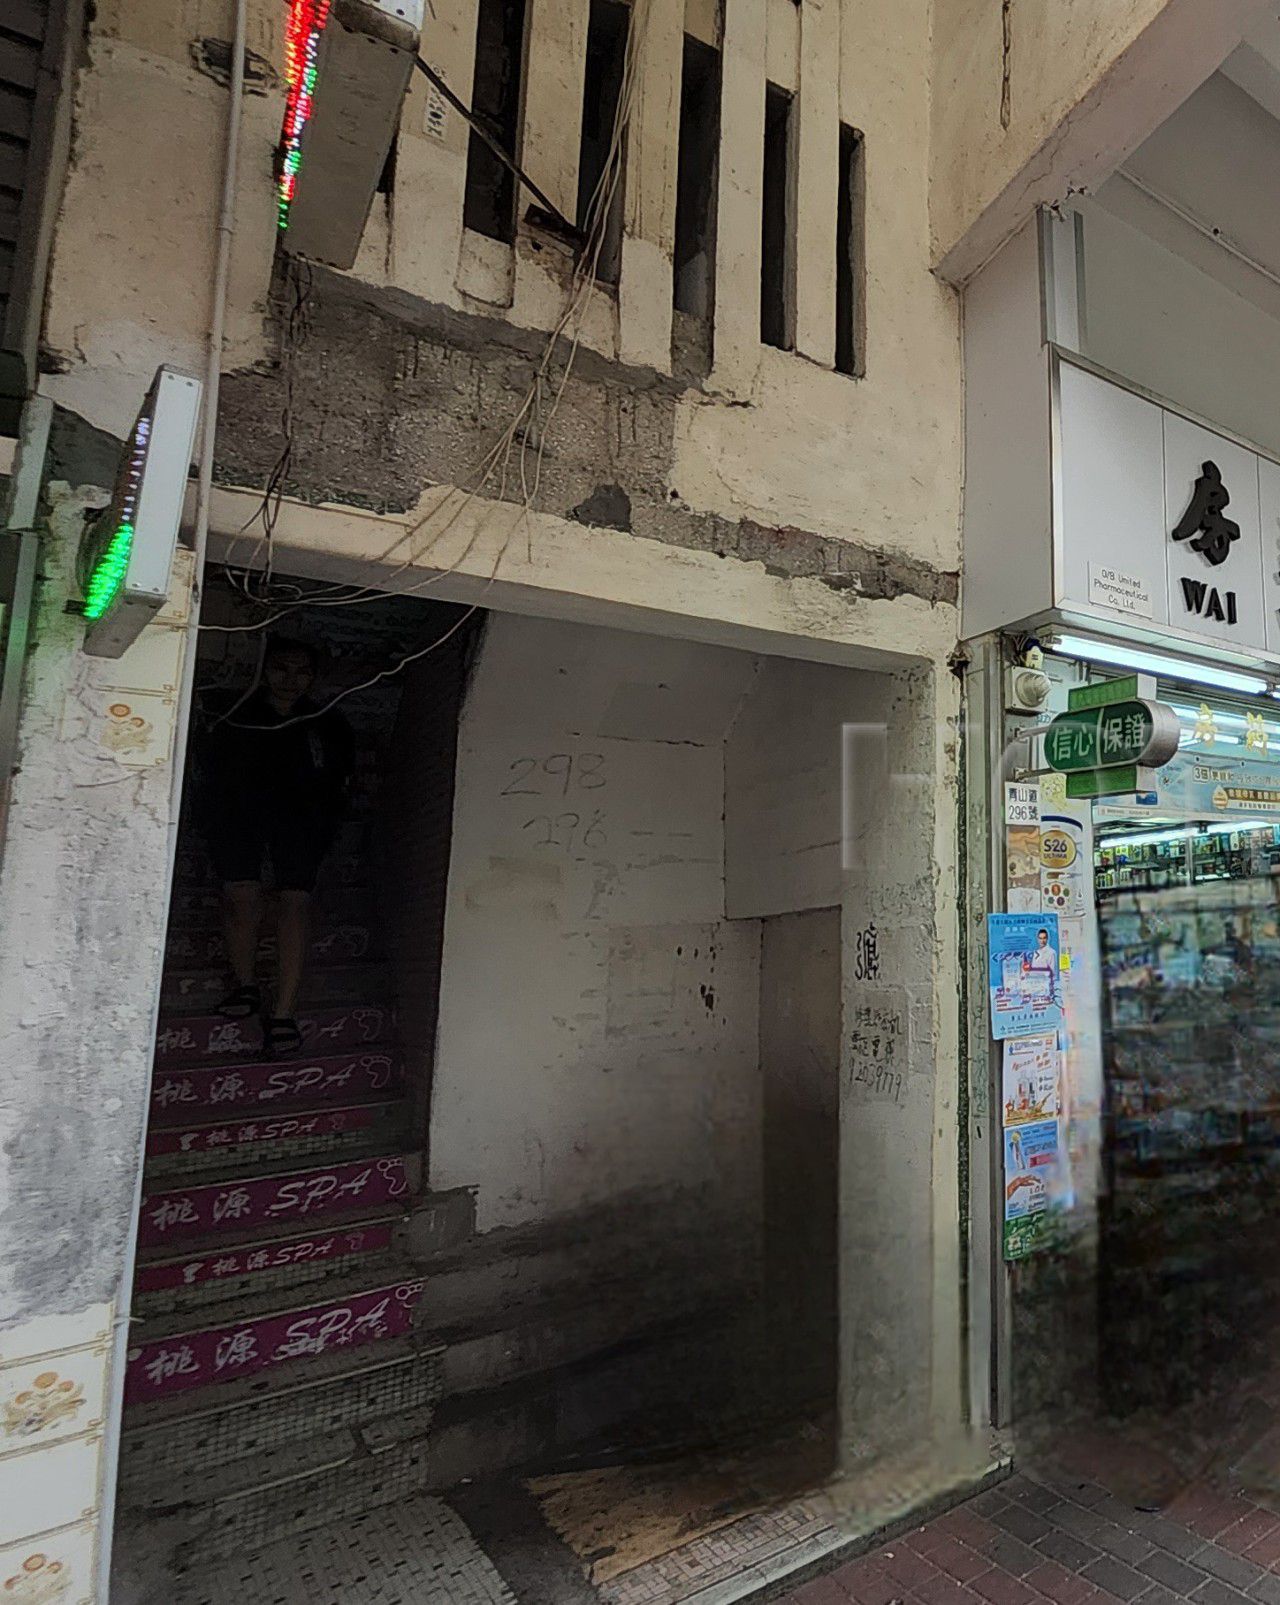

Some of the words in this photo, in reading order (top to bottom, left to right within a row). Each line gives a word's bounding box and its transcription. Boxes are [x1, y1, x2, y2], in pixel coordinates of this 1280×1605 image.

[1093, 578, 1148, 602] Pharmaceutical
[1118, 574, 1141, 588] United
[1180, 577, 1237, 625] WAI
[1052, 712, 1146, 761] 信心保證
[153, 1073, 245, 1106] 桃源
[258, 1064, 357, 1099] SPA
[256, 1117, 318, 1140] SPA
[149, 1187, 252, 1231] 桃源
[267, 1167, 372, 1212] SPA
[211, 1249, 268, 1276] 桃源
[271, 1237, 334, 1266] SPA
[145, 1328, 258, 1385] 桃源
[271, 1297, 390, 1359] SPA
